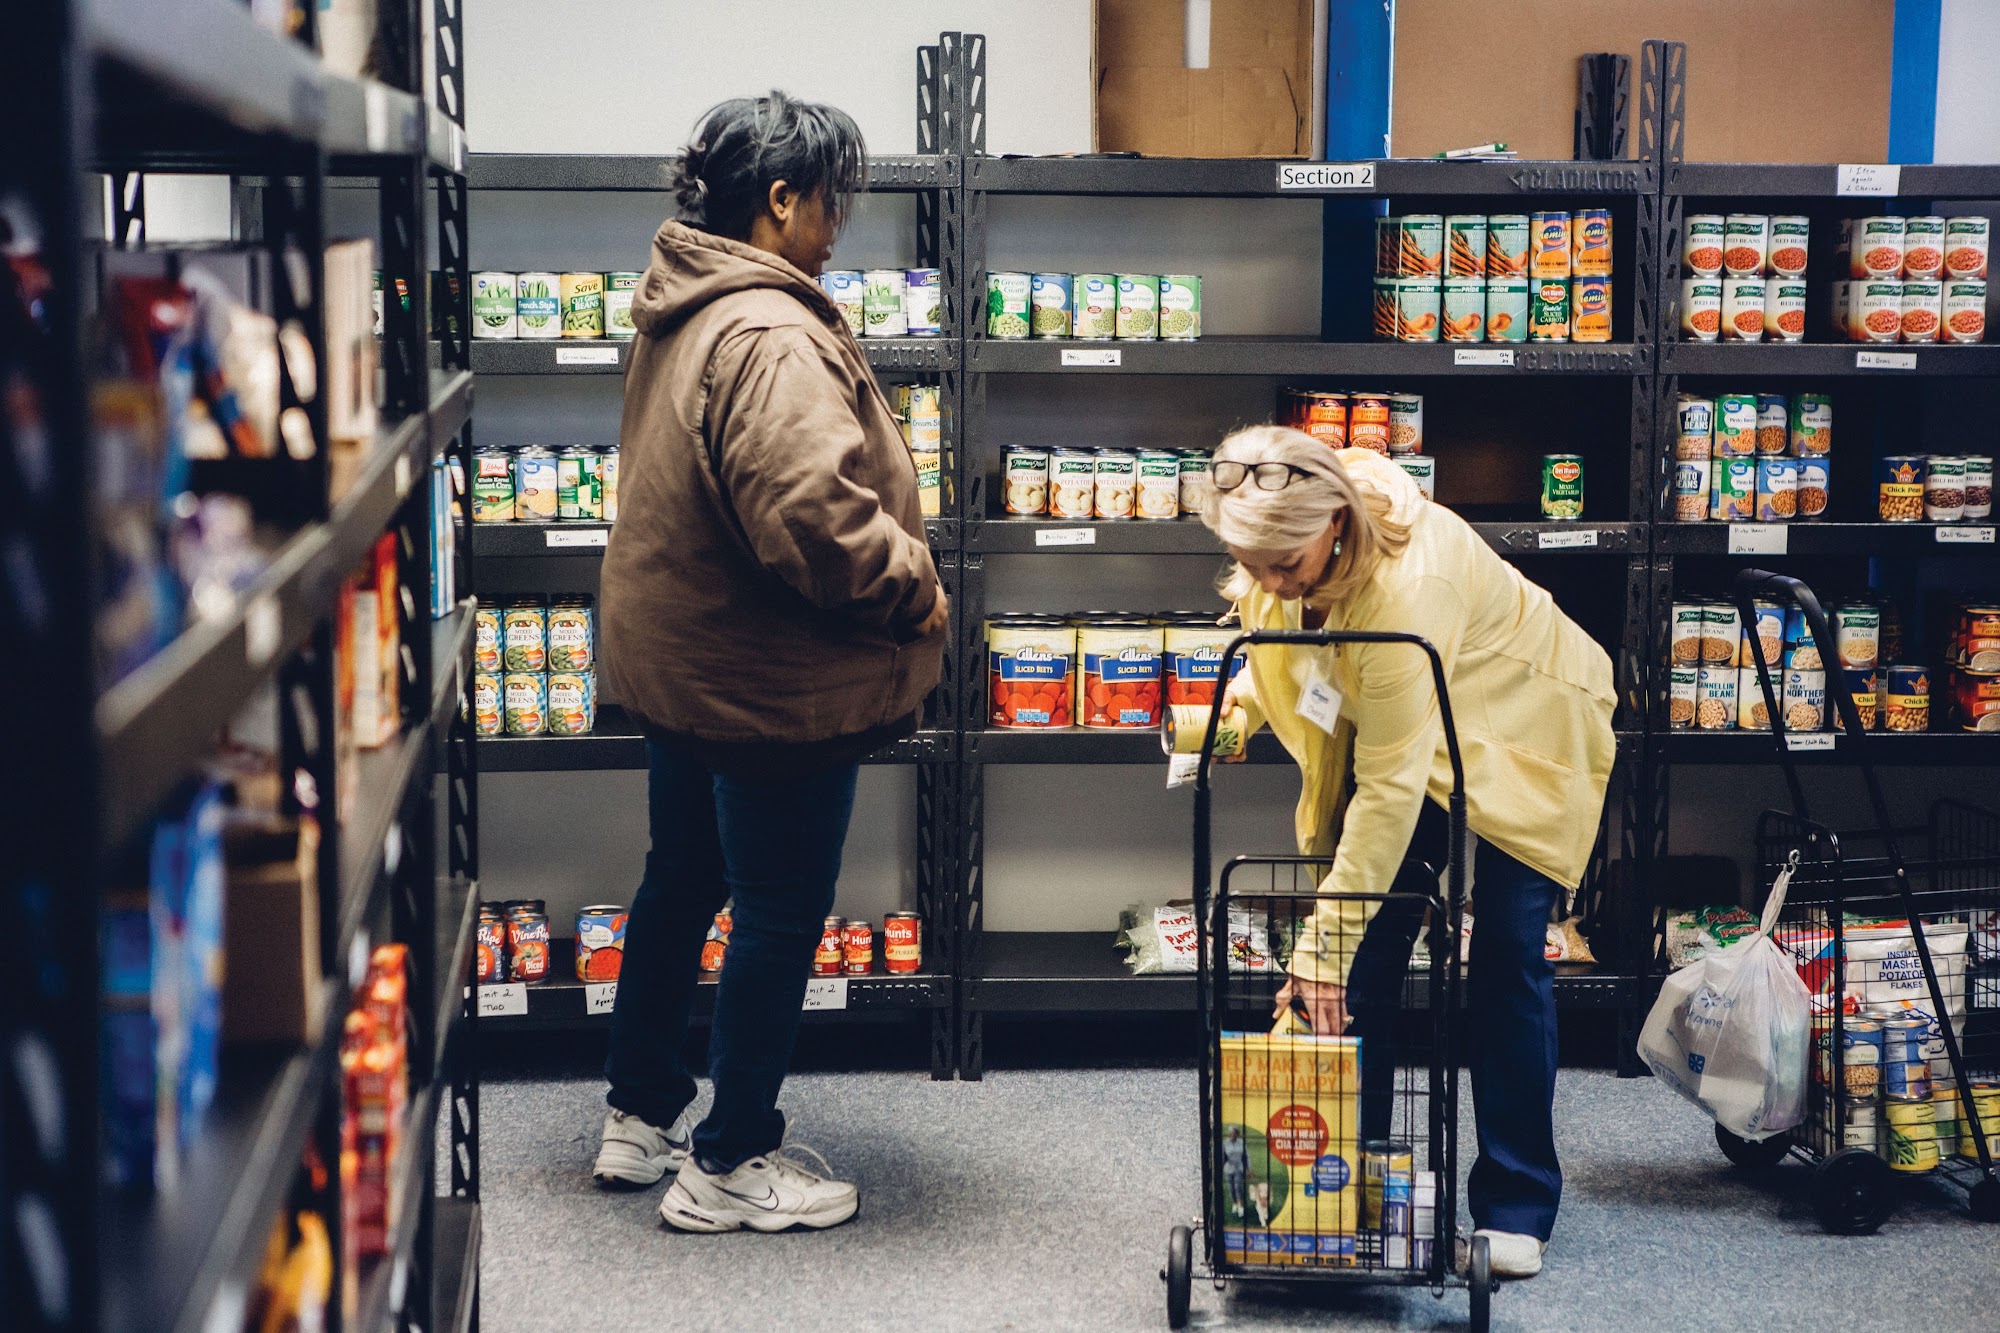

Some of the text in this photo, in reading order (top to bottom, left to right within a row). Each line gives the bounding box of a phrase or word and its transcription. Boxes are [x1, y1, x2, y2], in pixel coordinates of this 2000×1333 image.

[1284, 167, 1372, 186] Section 2
[1529, 171, 1638, 192] GLADIATOR
[574, 283, 599, 294] Save
[572, 295, 584, 304] CUT
[475, 304, 494, 314] Green
[495, 304, 515, 314] Beans
[575, 300, 599, 312] BEANS
[876, 302, 899, 312] Beans
[1686, 412, 1708, 422] PINTO
[912, 419, 932, 427] Cream
[1684, 421, 1709, 431] BEANS
[916, 459, 938, 471] Save
[1676, 471, 1697, 480] PINTO
[475, 482, 512, 490] Sweet Corn
[1193, 648, 1224, 662] Allen
[1036, 665, 1053, 673] BEETS
[1117, 665, 1153, 674] SLICED BEETS
[1191, 665, 1212, 673] SLICED
[1708, 689, 1735, 698] BEANS
[1706, 908, 1750, 924] Peak
[478, 926, 500, 945] Ripe
[511, 928, 533, 944] Vine
[1165, 929, 1198, 945] PAPPY
[1719, 926, 1760, 938] Peak
[1888, 950, 1920, 959] INSTANT
[526, 960, 544, 970] Diced
[1882, 959, 1921, 970] MASHE
[1879, 970, 1925, 981] POTATOE
[828, 985, 836, 993] 2
[1890, 981, 1924, 989] FLAKES
[478, 988, 514, 999] imit 2
[1308, 1059, 1352, 1075] YOUR
[1286, 1076, 1336, 1092] HAPPY
[1270, 1128, 1298, 1139] WHOLE
